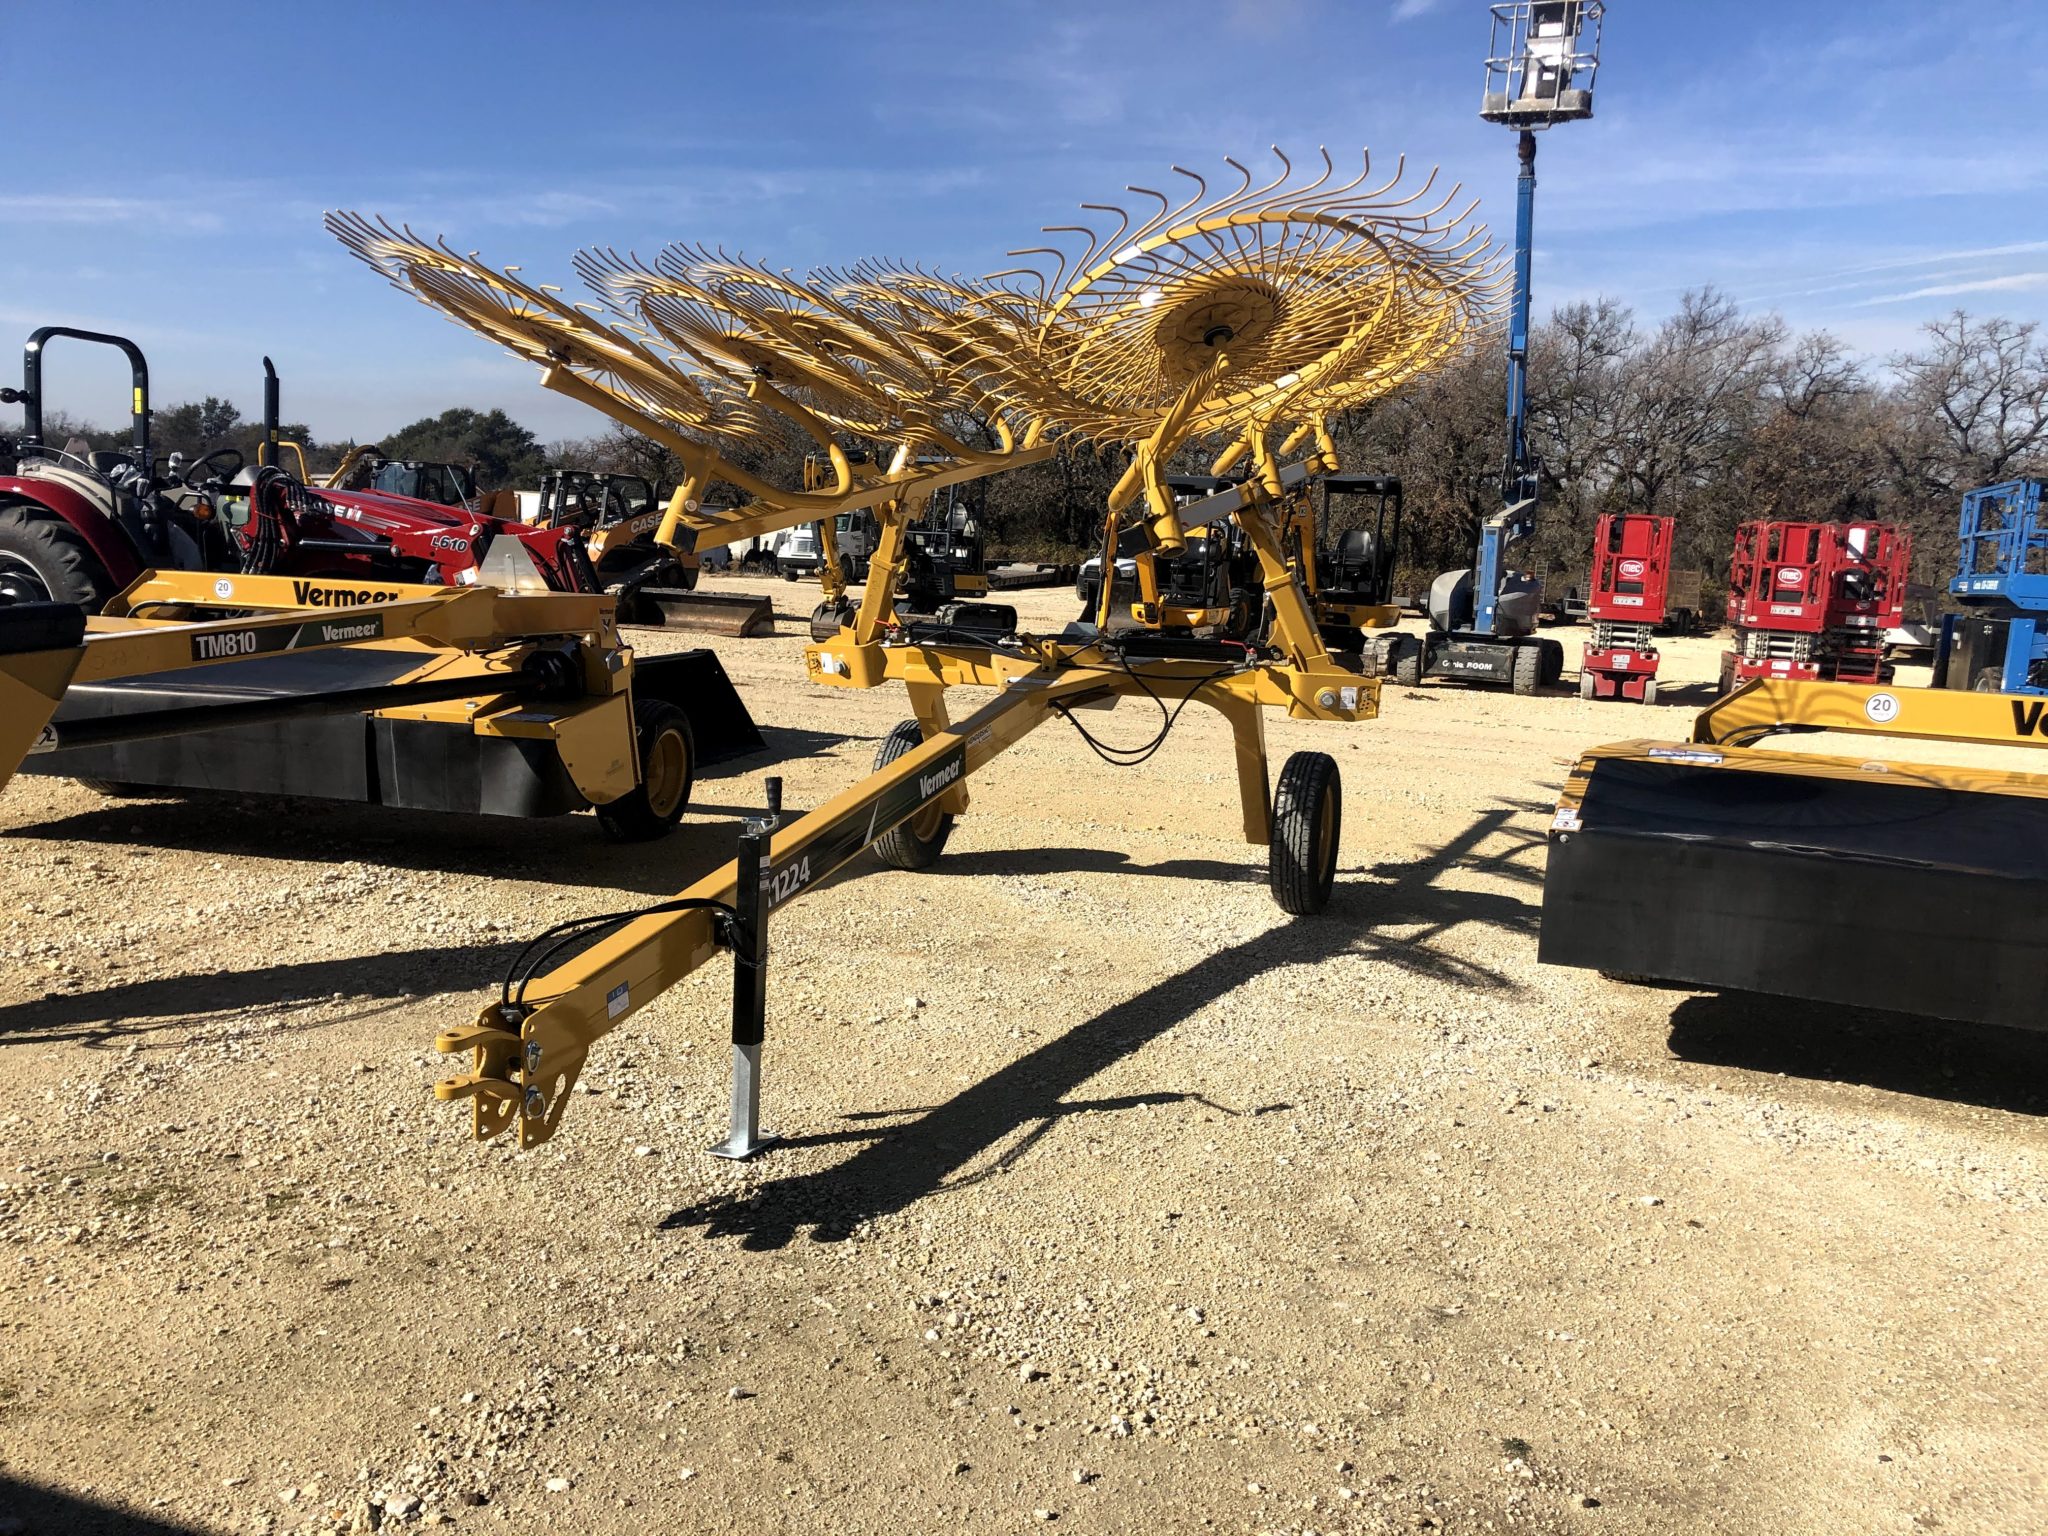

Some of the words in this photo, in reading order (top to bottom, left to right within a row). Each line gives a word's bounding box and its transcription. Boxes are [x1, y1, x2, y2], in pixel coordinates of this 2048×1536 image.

[630, 512, 662, 534] CASE
[431, 535, 468, 552] L610
[218, 583, 229, 592] 20
[293, 581, 398, 607] Vermeer
[321, 623, 376, 642] Vermeer
[195, 631, 256, 658] TM810
[1872, 698, 1891, 712] 20
[919, 760, 960, 799] Vermeer
[768, 855, 811, 908] 1224
